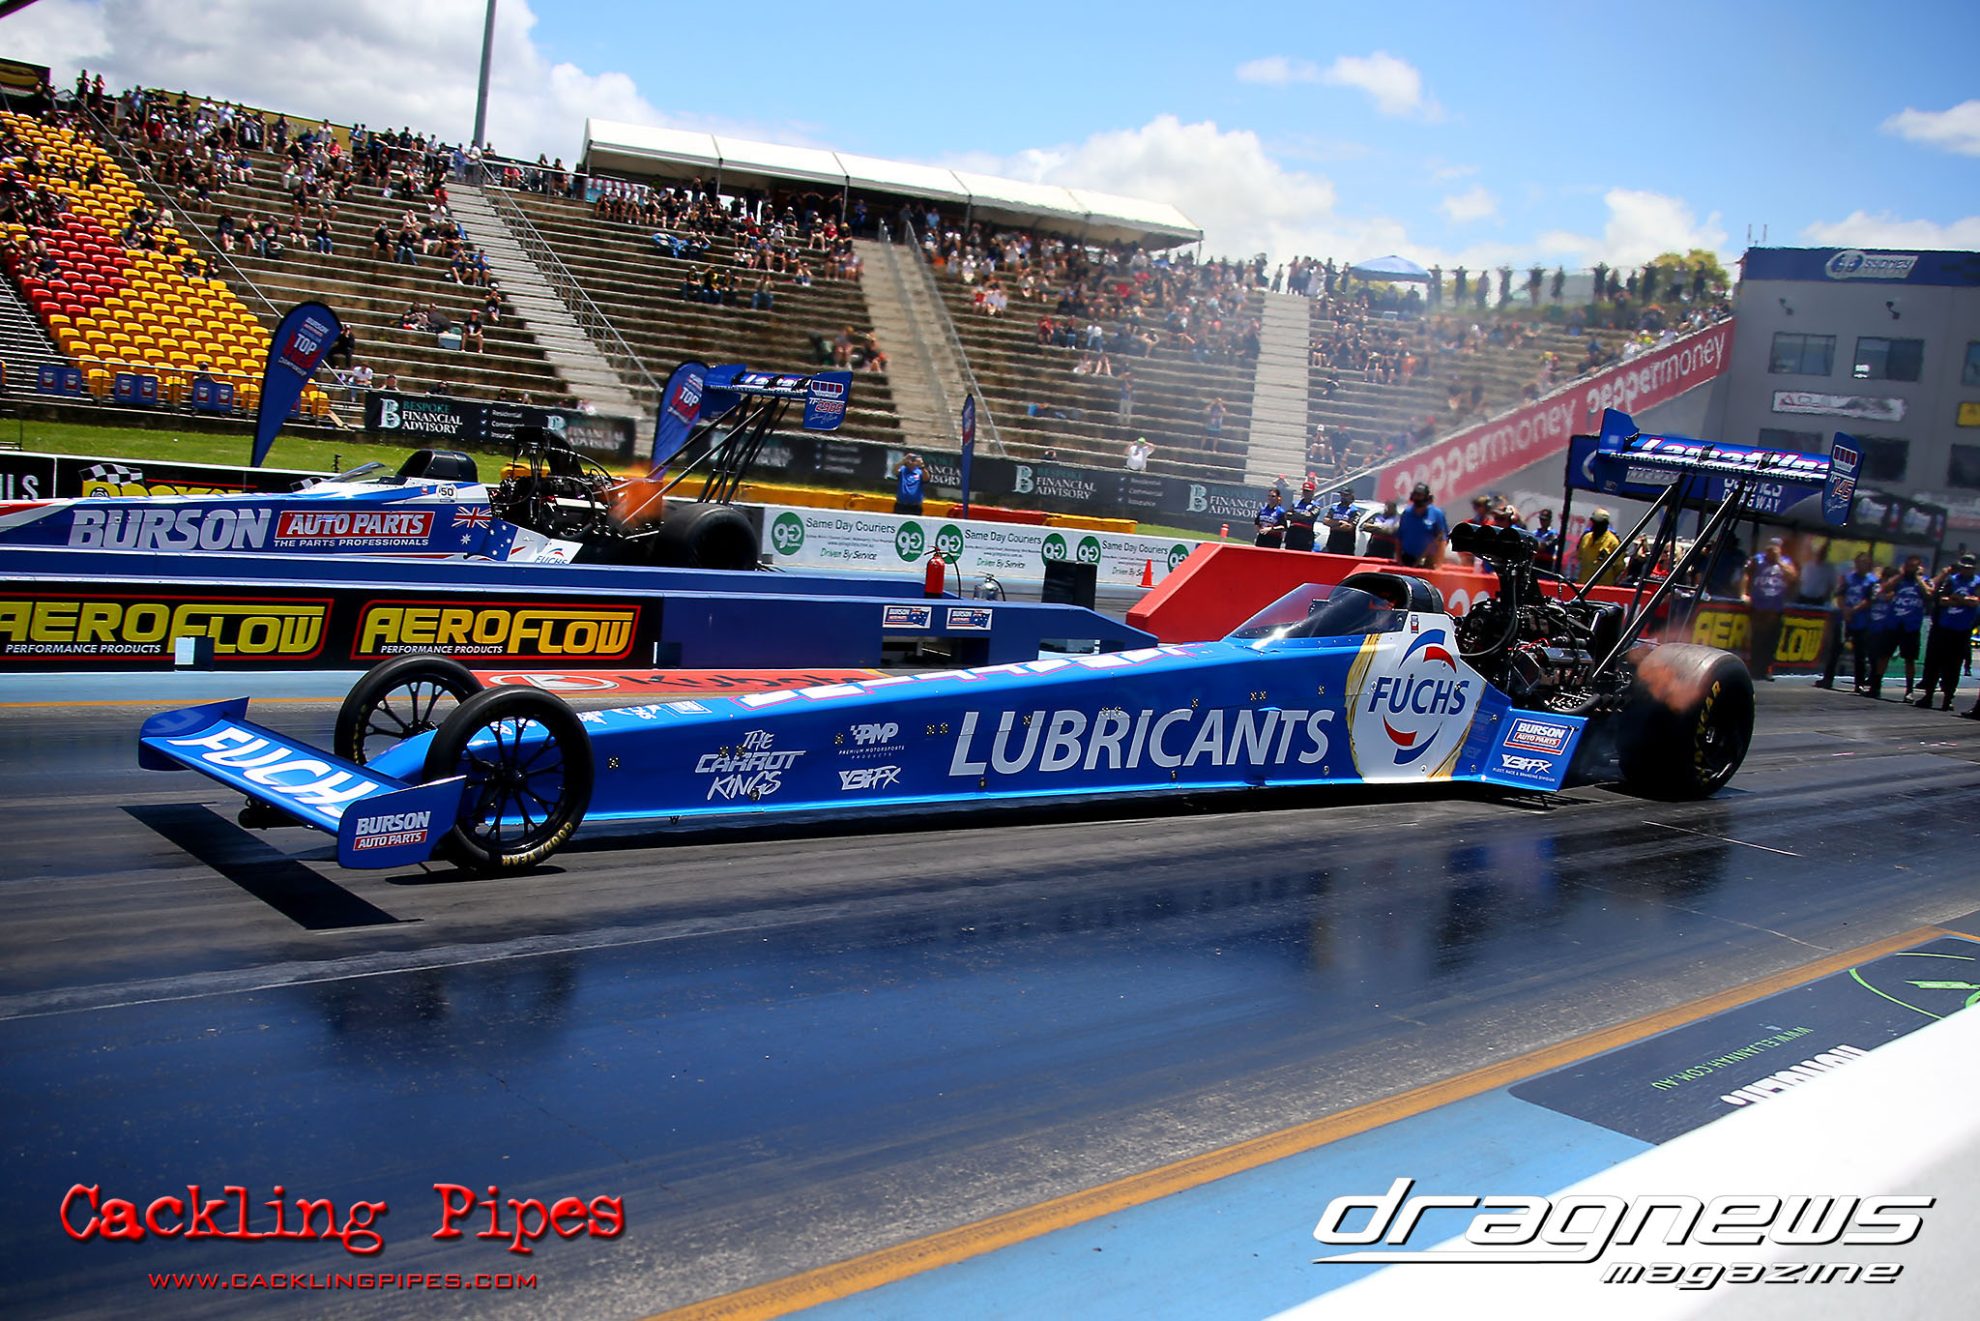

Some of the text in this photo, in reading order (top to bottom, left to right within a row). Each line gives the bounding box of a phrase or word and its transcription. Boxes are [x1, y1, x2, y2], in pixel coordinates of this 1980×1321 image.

[293, 333, 318, 356] TOP
[679, 387, 699, 407] TOP
[402, 411, 463, 426] FINANCIAL
[402, 422, 458, 434] ADVISORY
[1036, 476, 1097, 492] FINANCIAL
[1035, 486, 1093, 500] ADVISORY
[1721, 489, 1782, 513] DAGWAY
[1210, 495, 1267, 509] FINANCIA
[1209, 506, 1258, 519] ADVISOR
[68, 508, 272, 550] BURSON
[286, 513, 425, 535] AUTO PARTS
[806, 517, 896, 534] Same Day Couriers
[274, 538, 429, 547] THE PARTS PROFESSIONALS
[965, 529, 1042, 545] Same Day Couriers
[820, 548, 877, 561] Driven By Service
[1102, 540, 1168, 555] Same Day Couriers
[976, 557, 1026, 569] Driven By Service
[0, 601, 326, 654] AEROFLOW
[360, 607, 634, 655] AEROFLOW
[6, 644, 161, 655] PERFORMANCE PRODUCTS
[381, 645, 503, 655] PERFORMANCE PRODUCTS
[1367, 675, 1471, 716] FUCHS
[853, 722, 899, 745] PMP
[1517, 722, 1566, 739] BURSON
[743, 730, 776, 751] THE
[948, 708, 1336, 777] LUBRICANTS
[1517, 733, 1535, 742] AUTO
[1535, 735, 1557, 746] PARTS
[865, 745, 905, 753] MOTORSPORTS
[695, 750, 807, 774] CARROT
[167, 726, 380, 818] FUCH
[707, 770, 782, 801] KINGS
[355, 810, 431, 837] BURSON
[358, 832, 422, 849] AUTO PARTS
